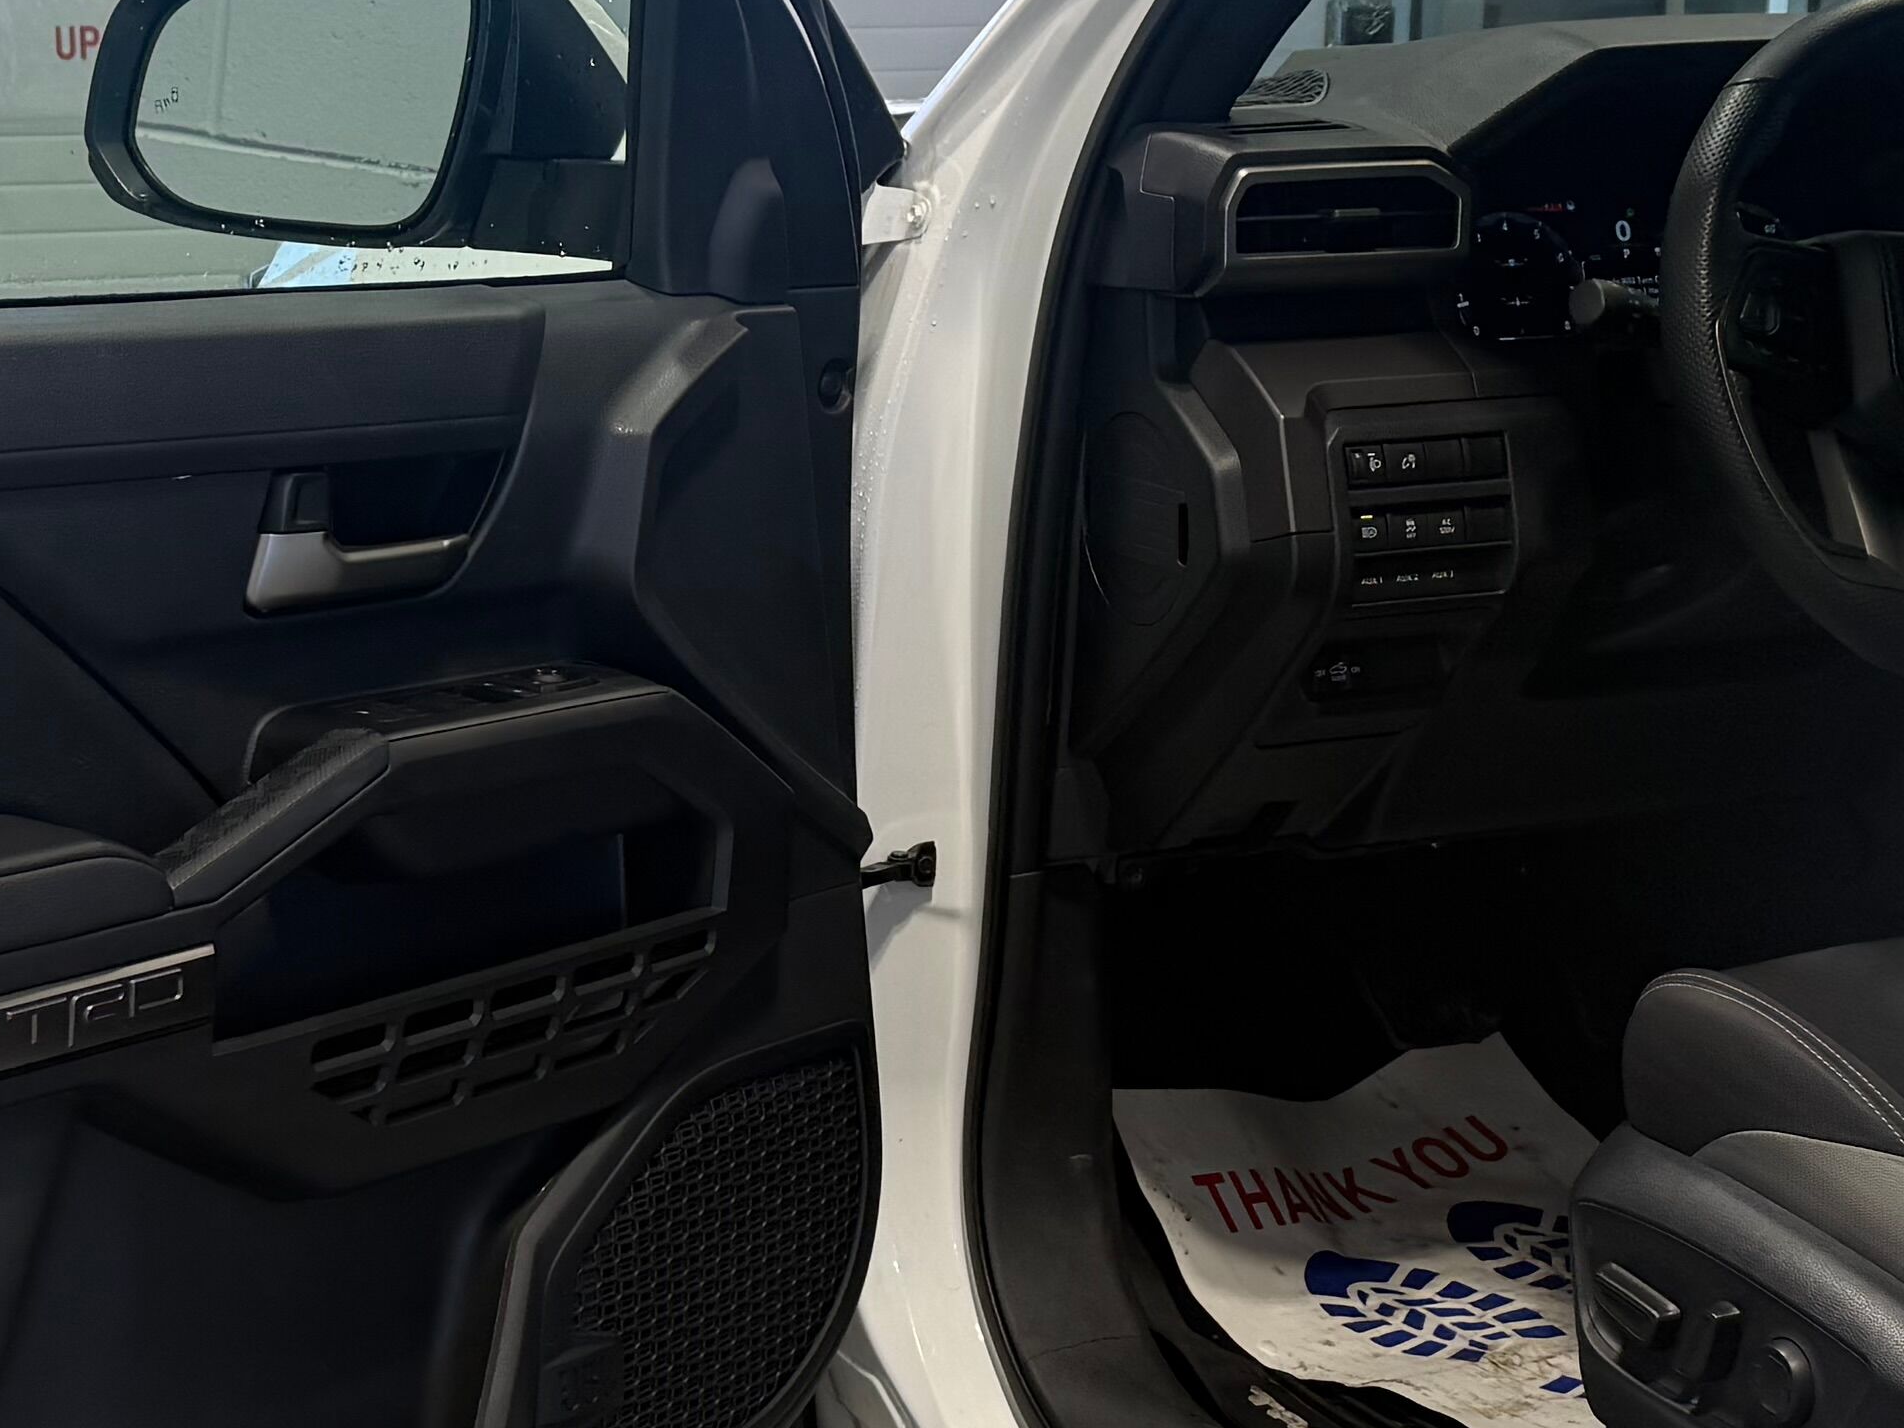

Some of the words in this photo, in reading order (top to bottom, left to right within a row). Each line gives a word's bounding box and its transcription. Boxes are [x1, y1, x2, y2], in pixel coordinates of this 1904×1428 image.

[54, 24, 100, 62] UP
[1615, 220, 1631, 242] 0
[6, 968, 186, 1049] TRD
[1191, 1166, 1399, 1234] THANK
[1368, 1114, 1509, 1190] YOU
